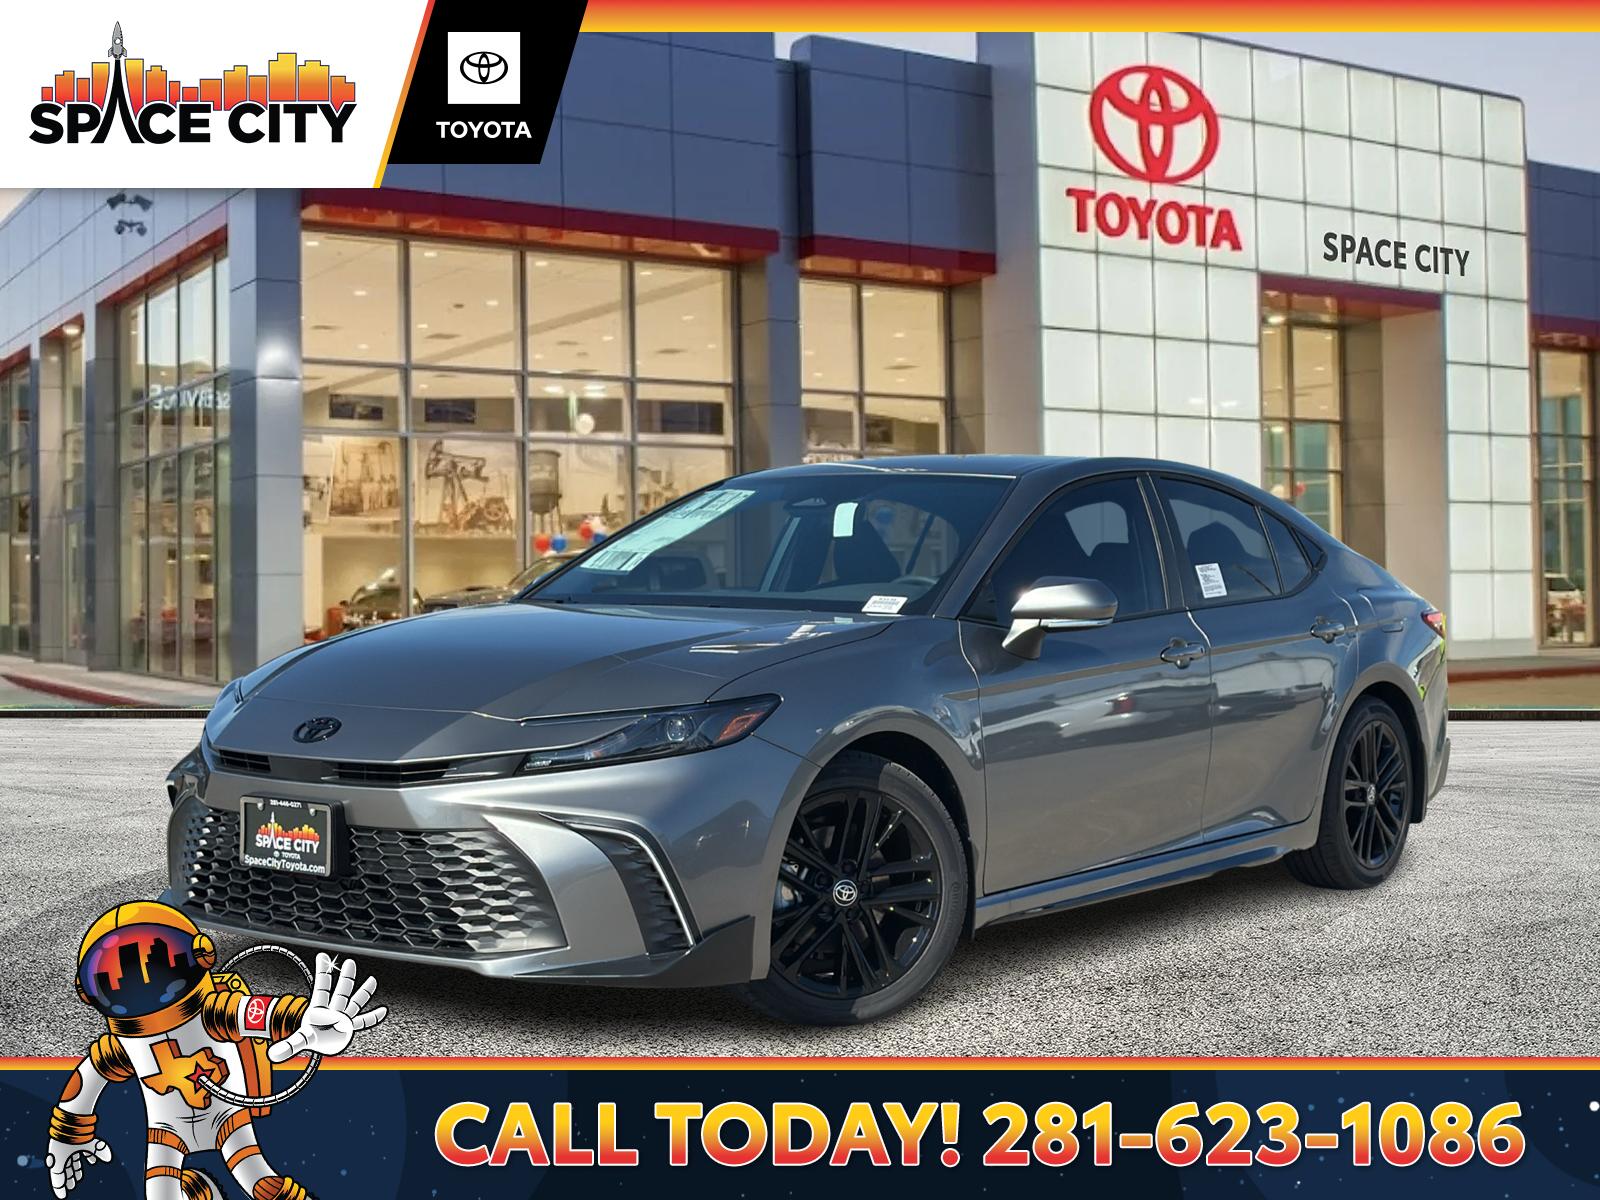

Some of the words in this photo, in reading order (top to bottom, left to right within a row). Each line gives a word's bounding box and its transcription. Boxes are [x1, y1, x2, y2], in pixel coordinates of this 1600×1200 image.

[1066, 188, 1242, 251] TOYOTA
[1323, 232, 1407, 270] SPACE
[1415, 245, 1470, 277] CITY
[255, 835, 292, 850] SPACE
[294, 839, 320, 854] CITY
[244, 854, 325, 873] SpaceCityToyota.com
[282, 851, 301, 860] TOYOTA
